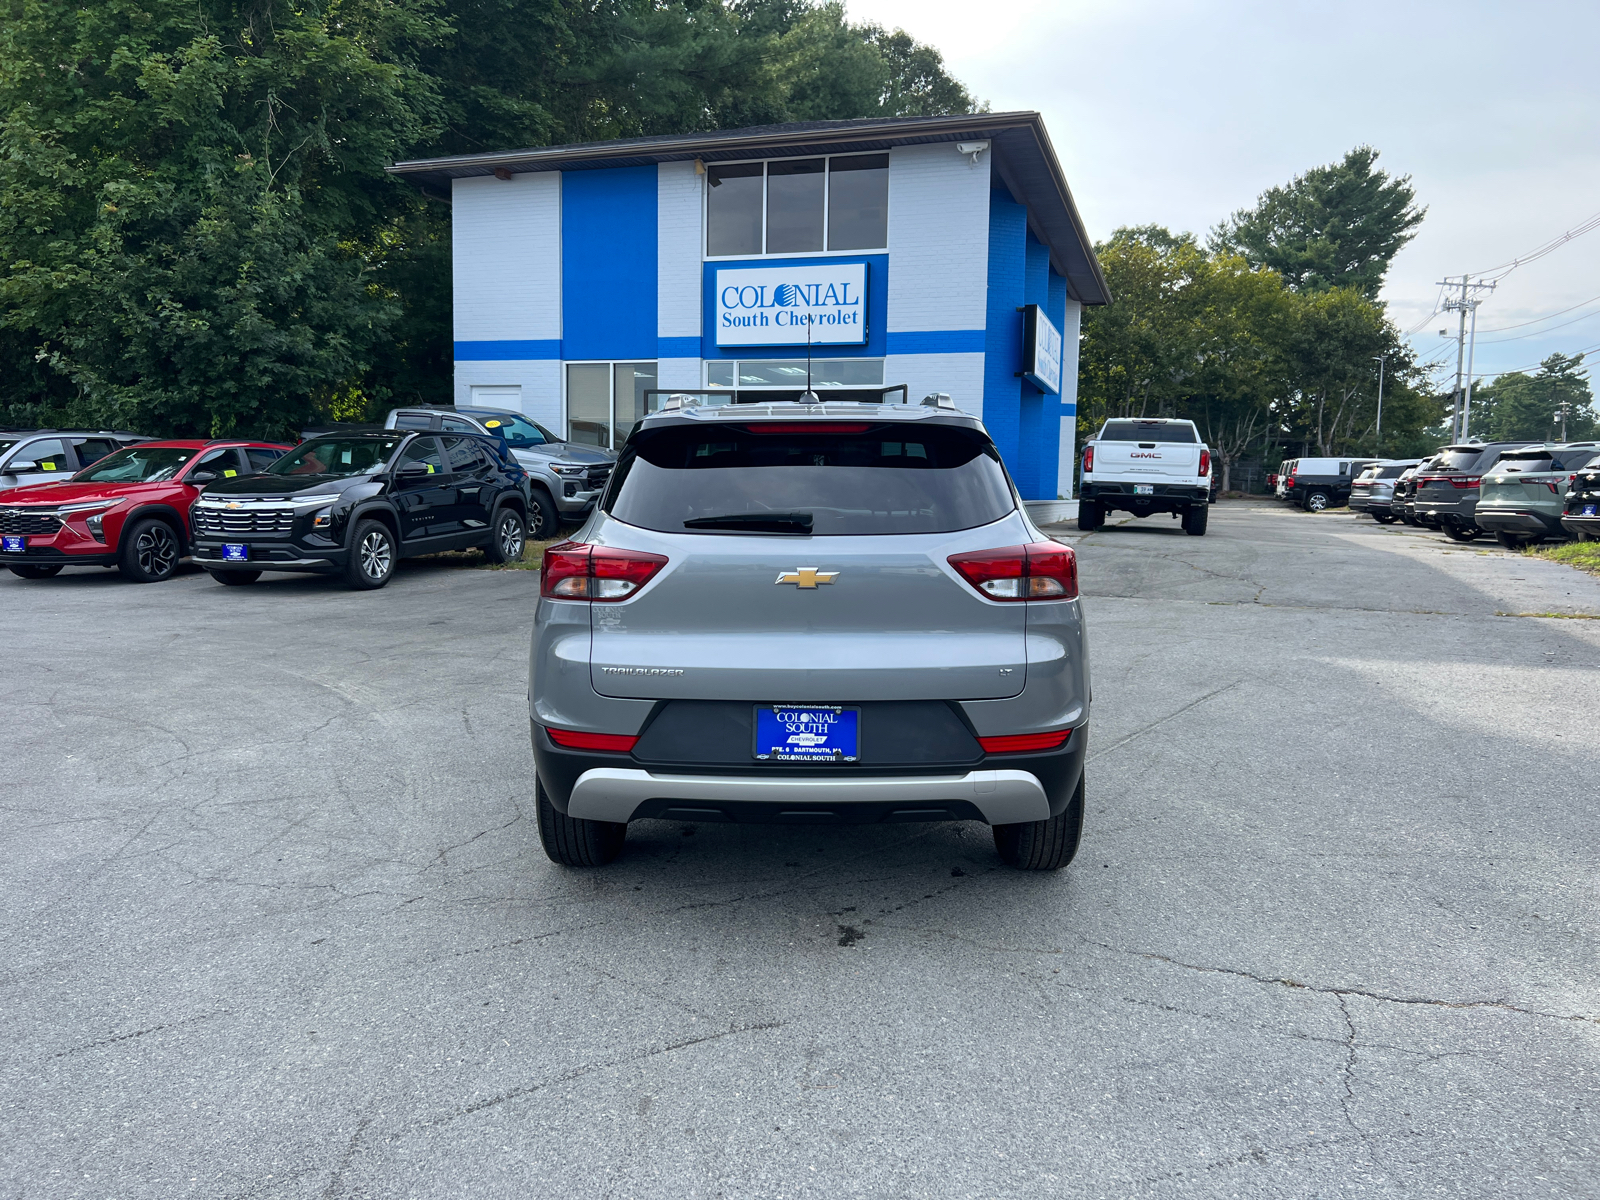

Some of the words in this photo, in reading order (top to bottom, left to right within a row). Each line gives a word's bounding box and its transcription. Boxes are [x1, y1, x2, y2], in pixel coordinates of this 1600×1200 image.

[721, 283, 859, 309] COLONIAL
[722, 312, 769, 327] South
[775, 310, 858, 326] Chevrolet
[601, 667, 684, 676] TRAILBLAZER
[999, 668, 1013, 676] LT
[776, 712, 838, 724] COLONIAL
[785, 723, 829, 733] SOUTH
